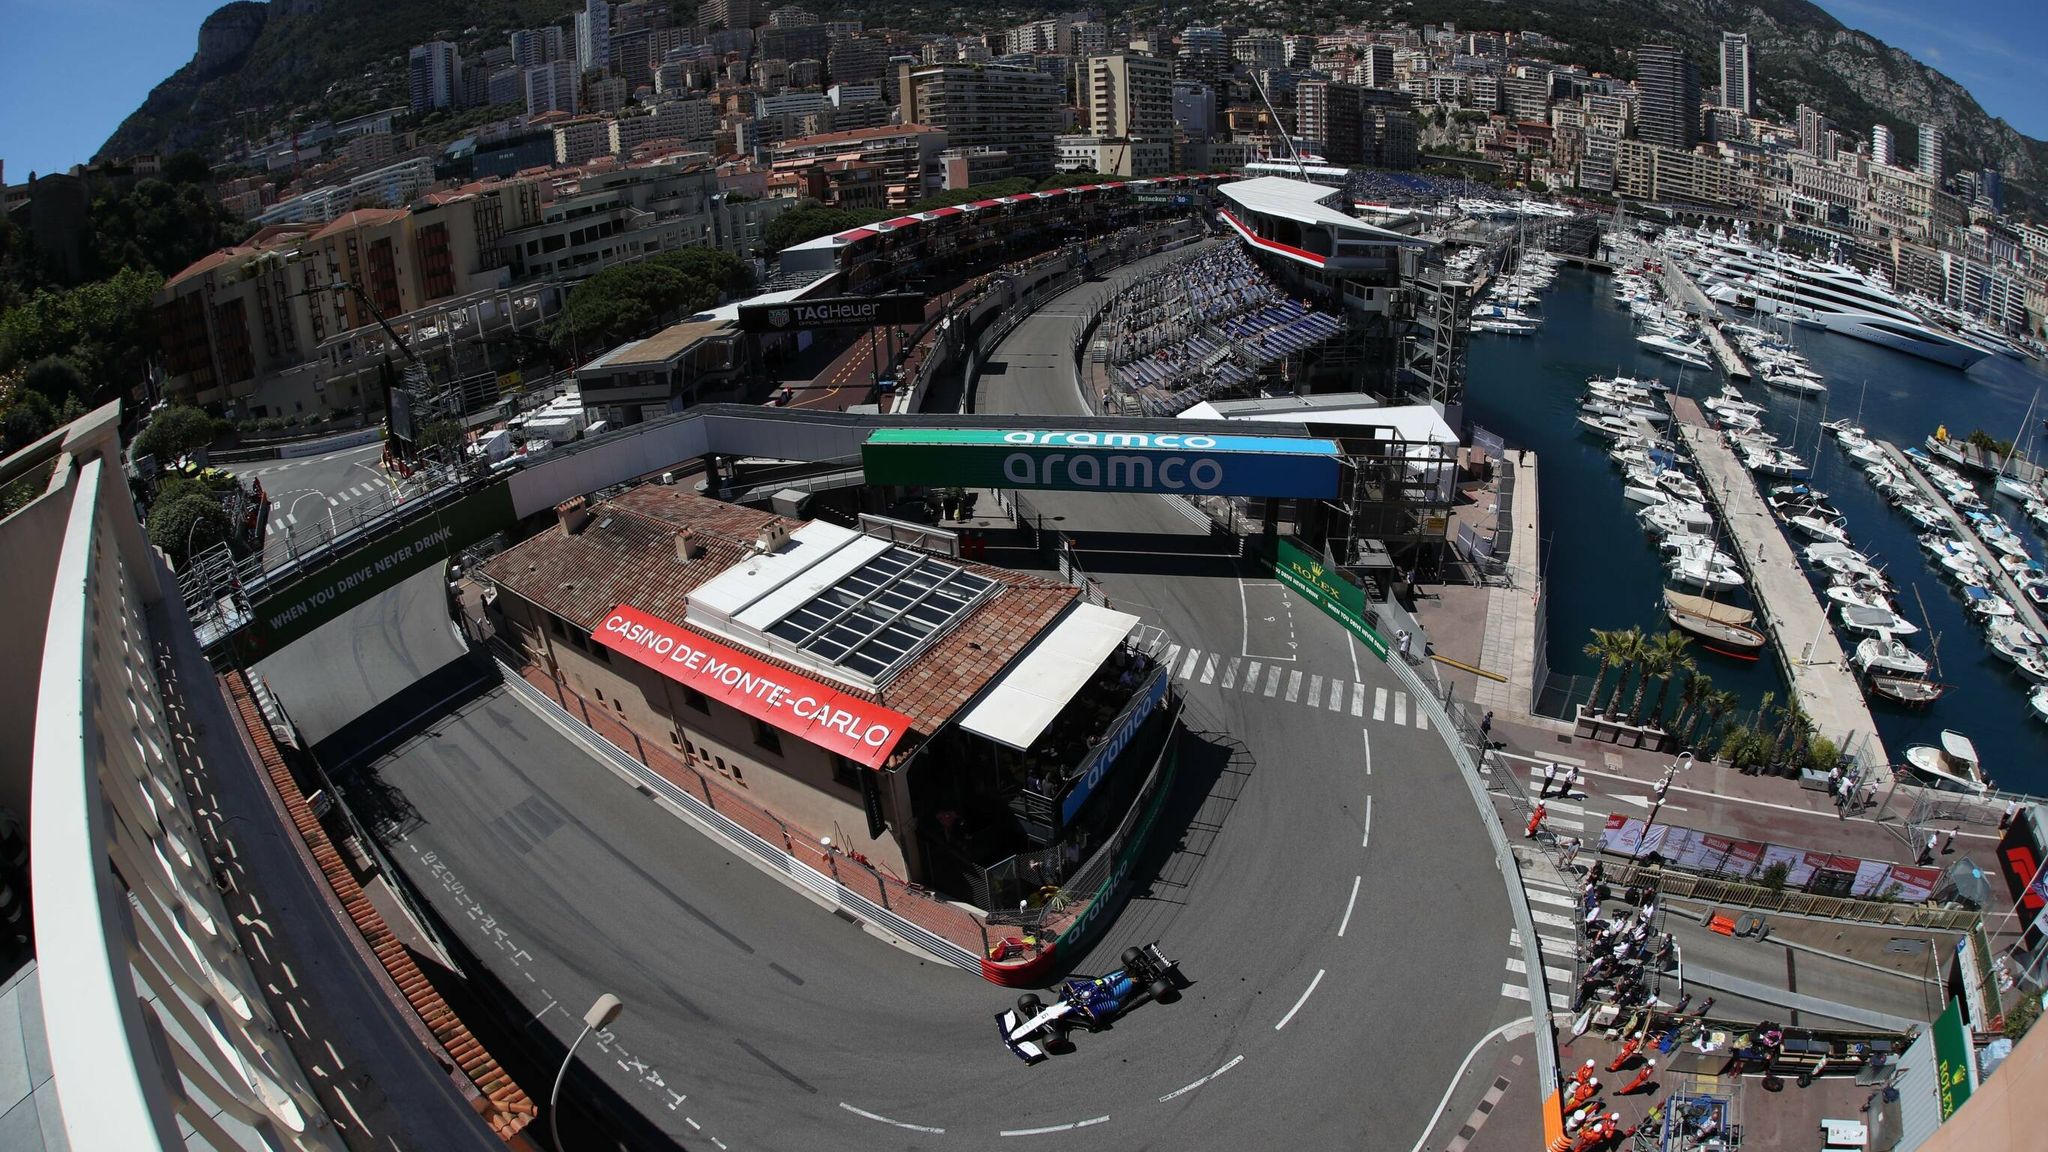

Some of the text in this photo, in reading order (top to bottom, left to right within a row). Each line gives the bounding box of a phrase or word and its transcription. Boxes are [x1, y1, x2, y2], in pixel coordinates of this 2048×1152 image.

[1003, 431, 1217, 449] aramco
[1003, 452, 1223, 490] aramco
[270, 526, 452, 630] WHEN YOU DRIVE NEVER DRINK
[1281, 571, 1293, 582] DRIVE
[1293, 578, 1305, 591] NEVER
[1306, 587, 1319, 600] DRINK
[1292, 563, 1340, 599] ROLEX
[1327, 602, 1386, 654] WHEN YOU DRIVE NEVER DRINK
[605, 615, 890, 748] CASINO DE MONTE-CARLO
[1086, 696, 1154, 790] aramco
[423, 850, 534, 964] LIVRAISONS
[1066, 859, 1129, 946] aramco
[1150, 944, 1173, 968] WILLIAMS
[595, 1026, 687, 1107] TAXIS
[1938, 1059, 1953, 1120] ROLEX
